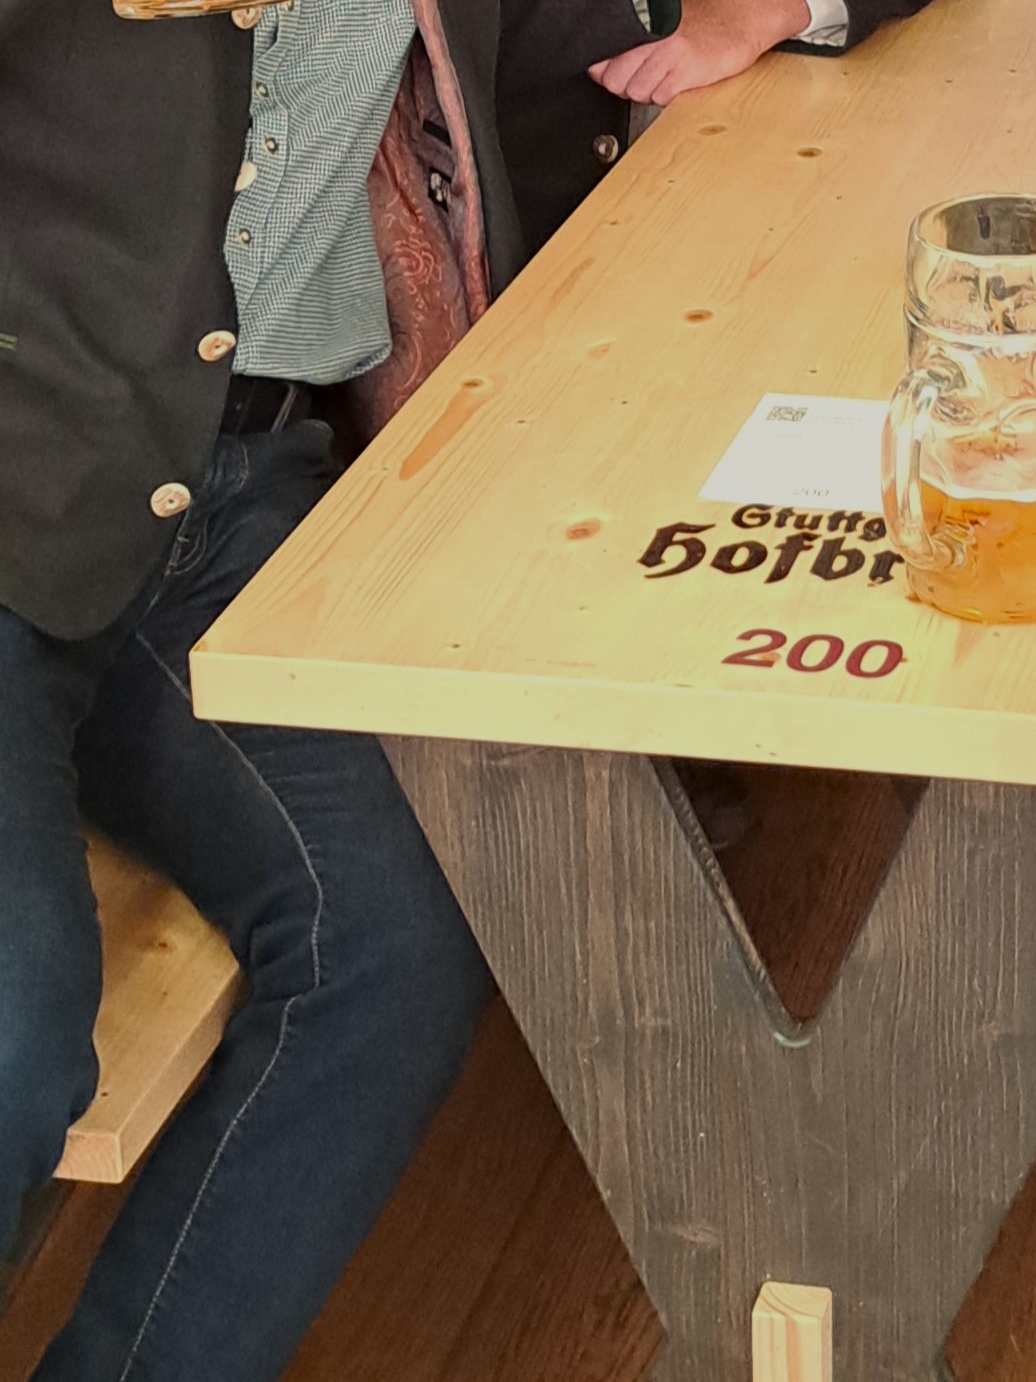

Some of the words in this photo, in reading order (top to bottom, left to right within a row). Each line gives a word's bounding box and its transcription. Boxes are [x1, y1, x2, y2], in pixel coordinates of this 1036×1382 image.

[731, 503, 887, 542] Stuttg
[638, 522, 905, 585] Hofbr
[721, 628, 904, 679] 200
